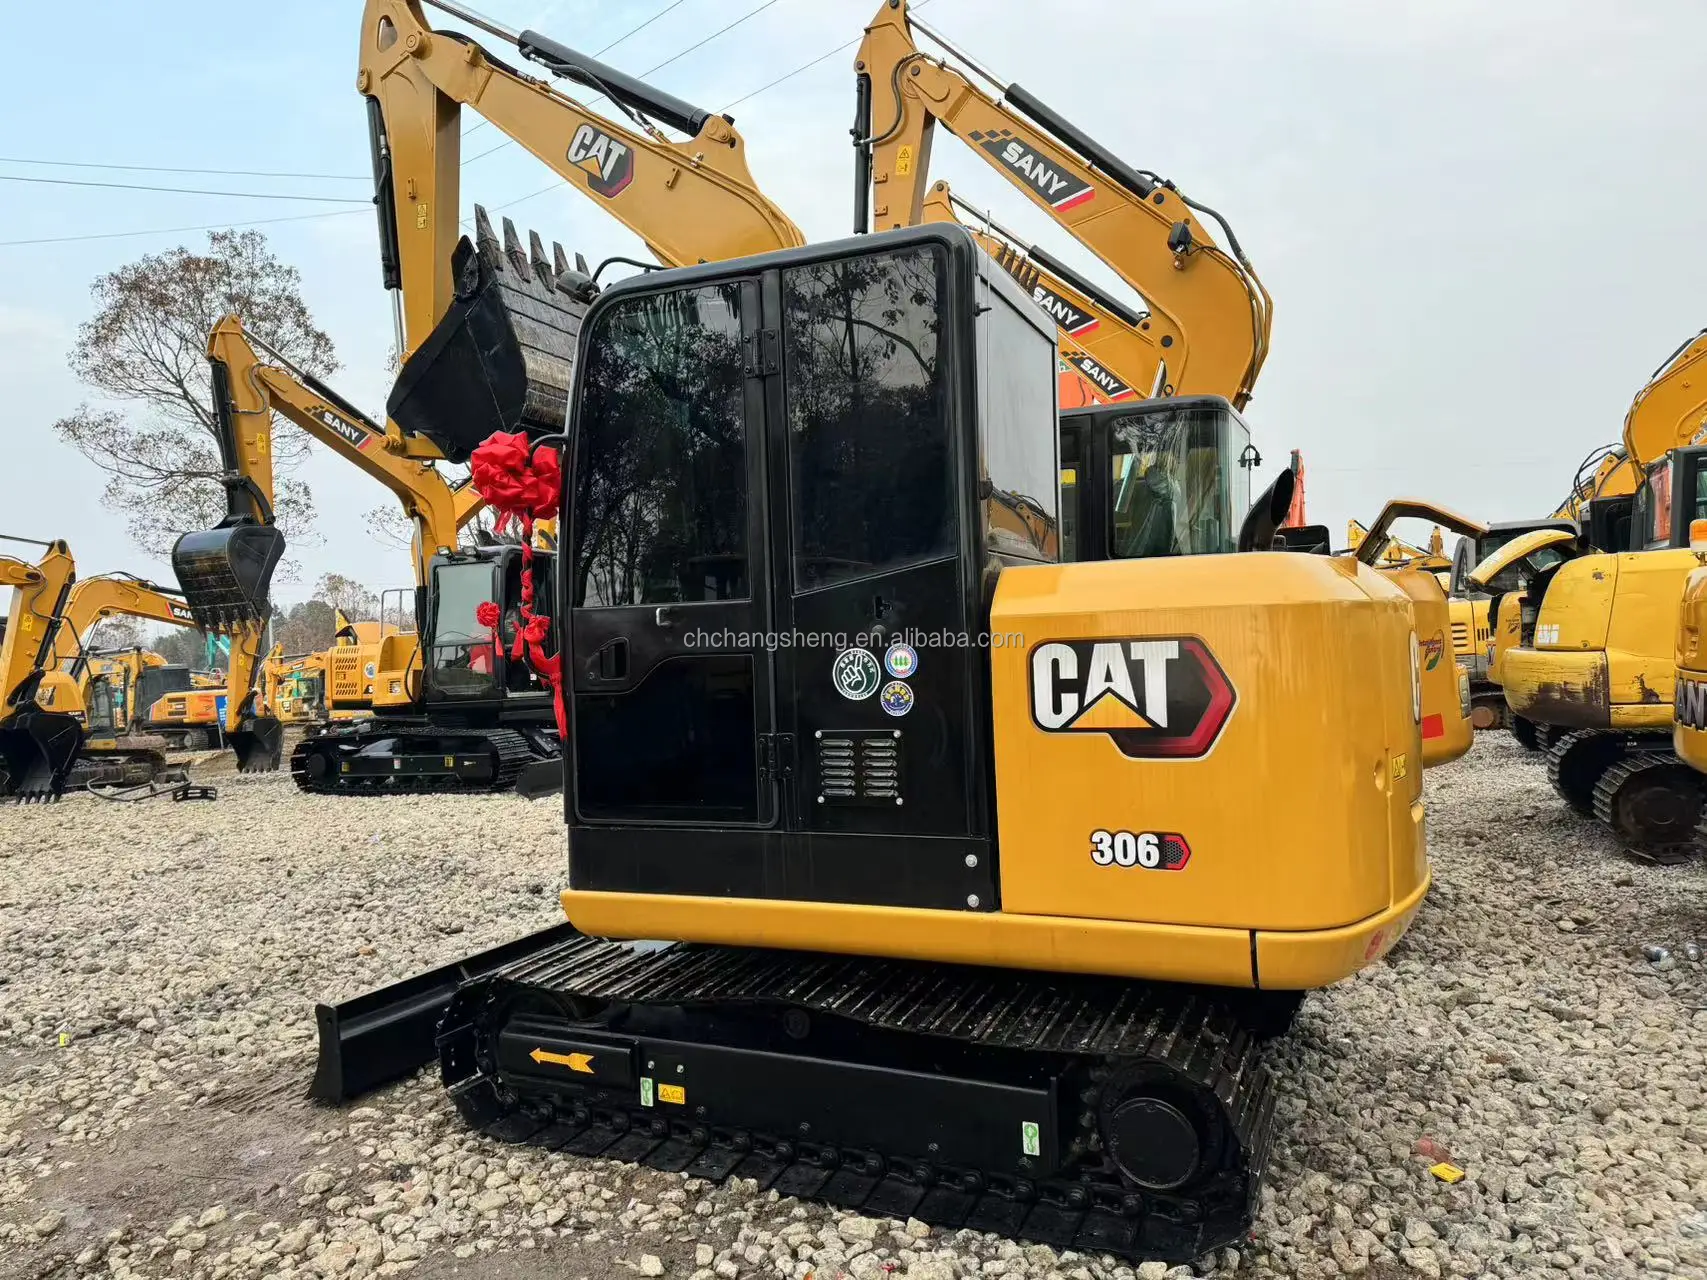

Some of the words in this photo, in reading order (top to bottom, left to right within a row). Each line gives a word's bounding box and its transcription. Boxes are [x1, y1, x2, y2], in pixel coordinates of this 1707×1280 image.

[567, 124, 627, 182] CAT
[1001, 142, 1068, 196] SANY
[1033, 287, 1081, 325] SANY
[1080, 358, 1120, 392] SANY
[323, 411, 358, 442] SANY
[1032, 641, 1179, 729] CAT
[1090, 831, 1161, 867] 306
